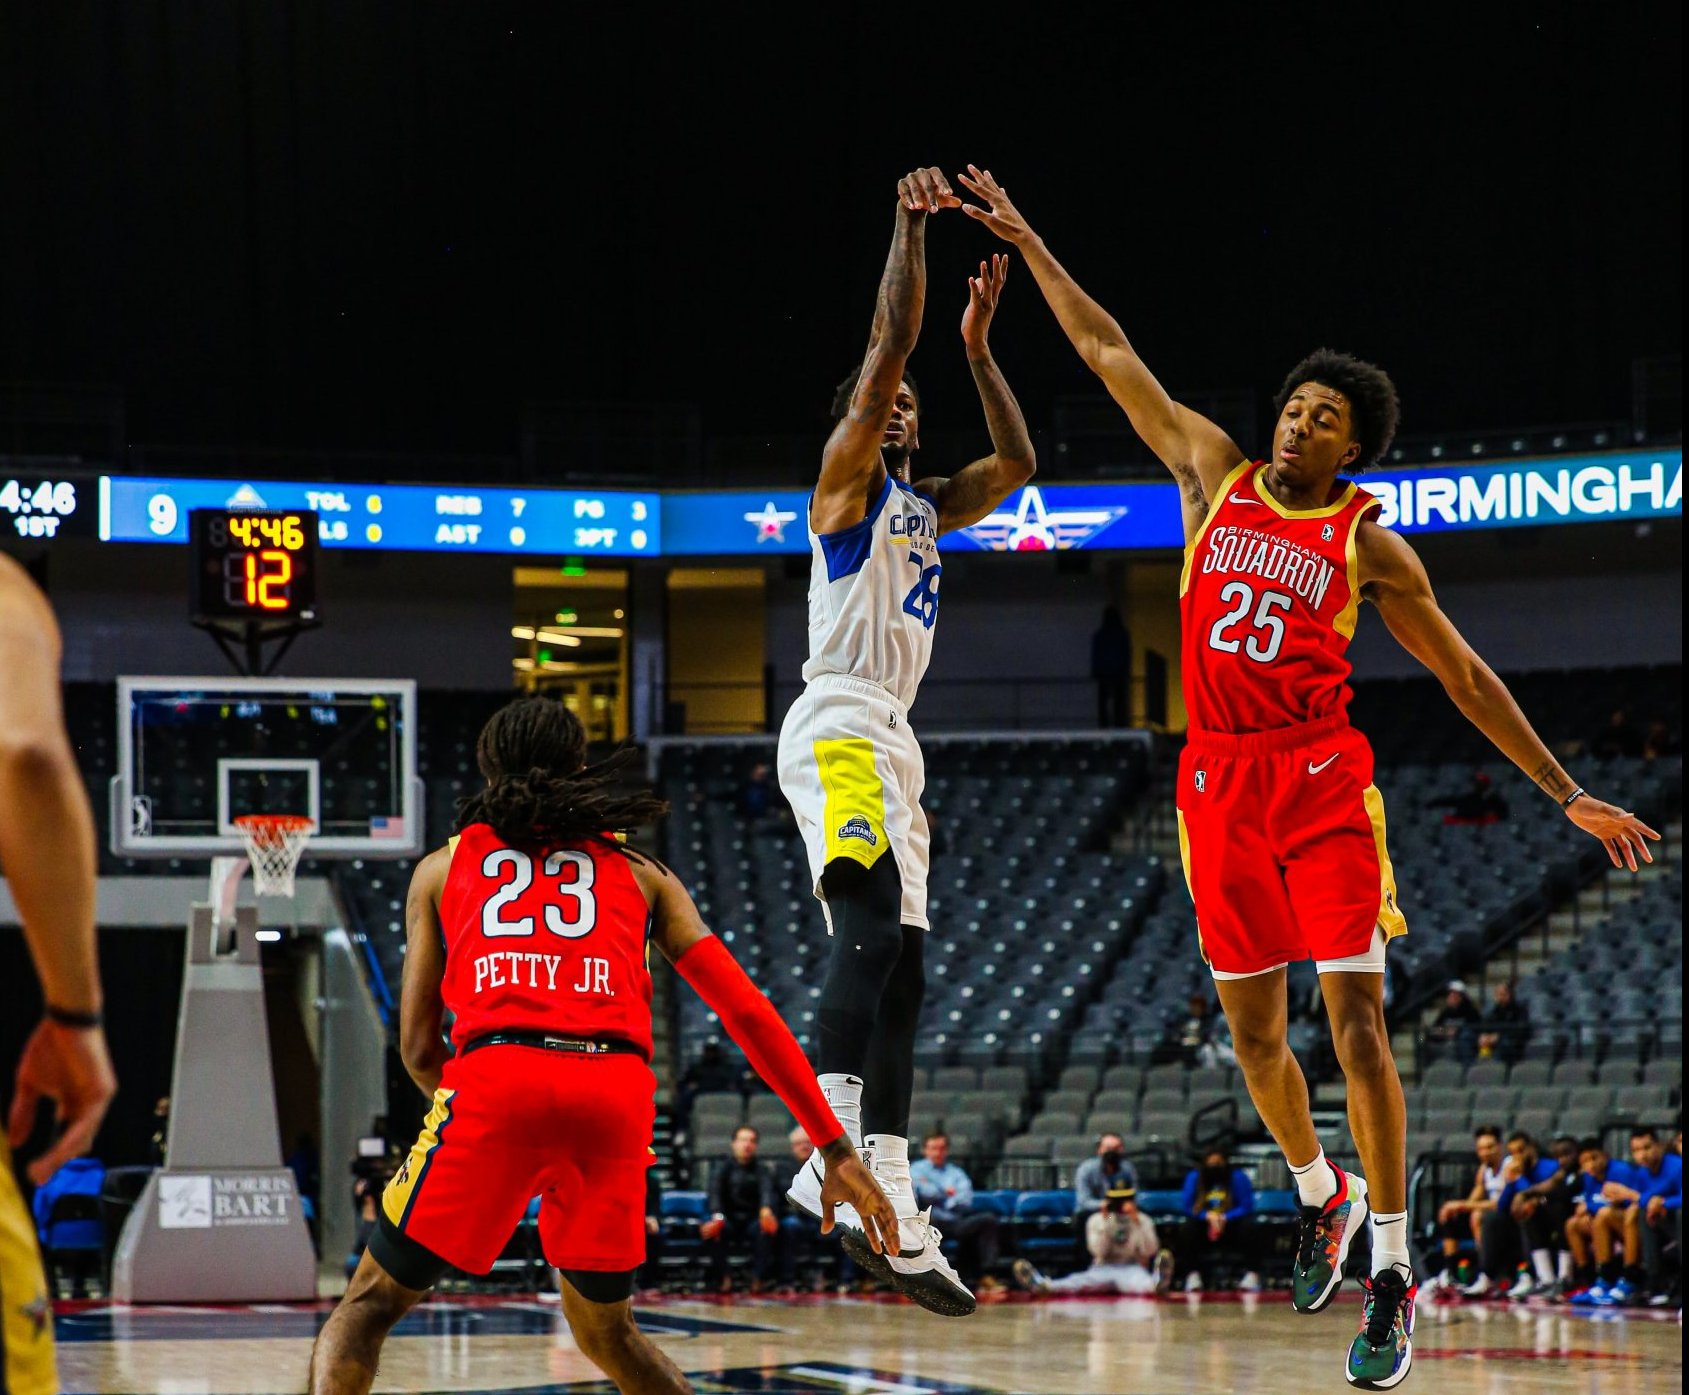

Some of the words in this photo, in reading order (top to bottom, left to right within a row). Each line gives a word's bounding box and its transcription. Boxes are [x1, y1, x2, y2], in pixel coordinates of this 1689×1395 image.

[0, 480, 76, 515] 4:46
[148, 494, 177, 535] 9
[510, 497, 526, 518] 7
[632, 501, 647, 521] 3
[14, 515, 60, 537] 1ST
[230, 516, 304, 550] 4:46
[318, 520, 348, 540] LS
[366, 523, 382, 543] 0
[435, 523, 482, 544] AST
[509, 526, 526, 546] 0
[631, 529, 647, 549] 0
[1227, 526, 1322, 562] BIRMINGHAM
[245, 551, 291, 609] 12
[1202, 527, 1335, 611] SQUADRON
[903, 551, 943, 630] 28
[1208, 580, 1292, 663] 25
[840, 826, 876, 842] CAPITANES
[482, 848, 597, 938] 23
[474, 952, 562, 993] PETTY
[574, 957, 615, 996] JR.
[213, 1176, 291, 1193] MORRIS
[214, 1193, 292, 1216] BART
